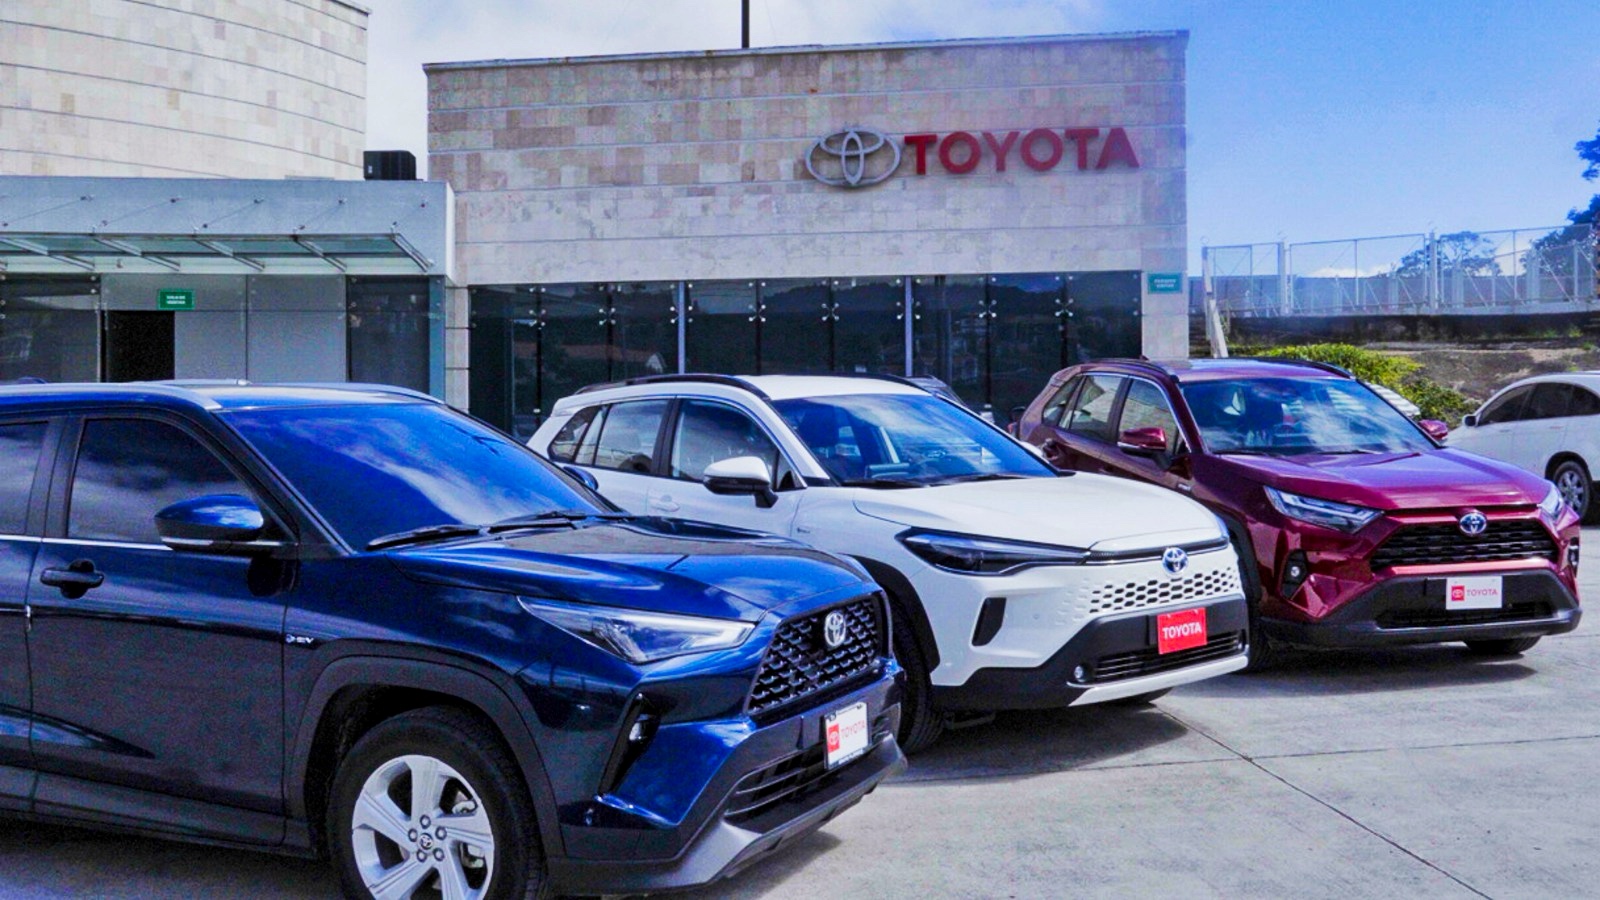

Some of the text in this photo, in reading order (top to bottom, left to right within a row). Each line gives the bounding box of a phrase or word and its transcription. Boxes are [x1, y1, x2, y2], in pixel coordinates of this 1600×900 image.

[904, 127, 1140, 175] TOYOTA
[1467, 588, 1498, 597] TOYOTA
[1162, 622, 1202, 640] TOYOTA
[841, 720, 866, 739] TOYOTA
